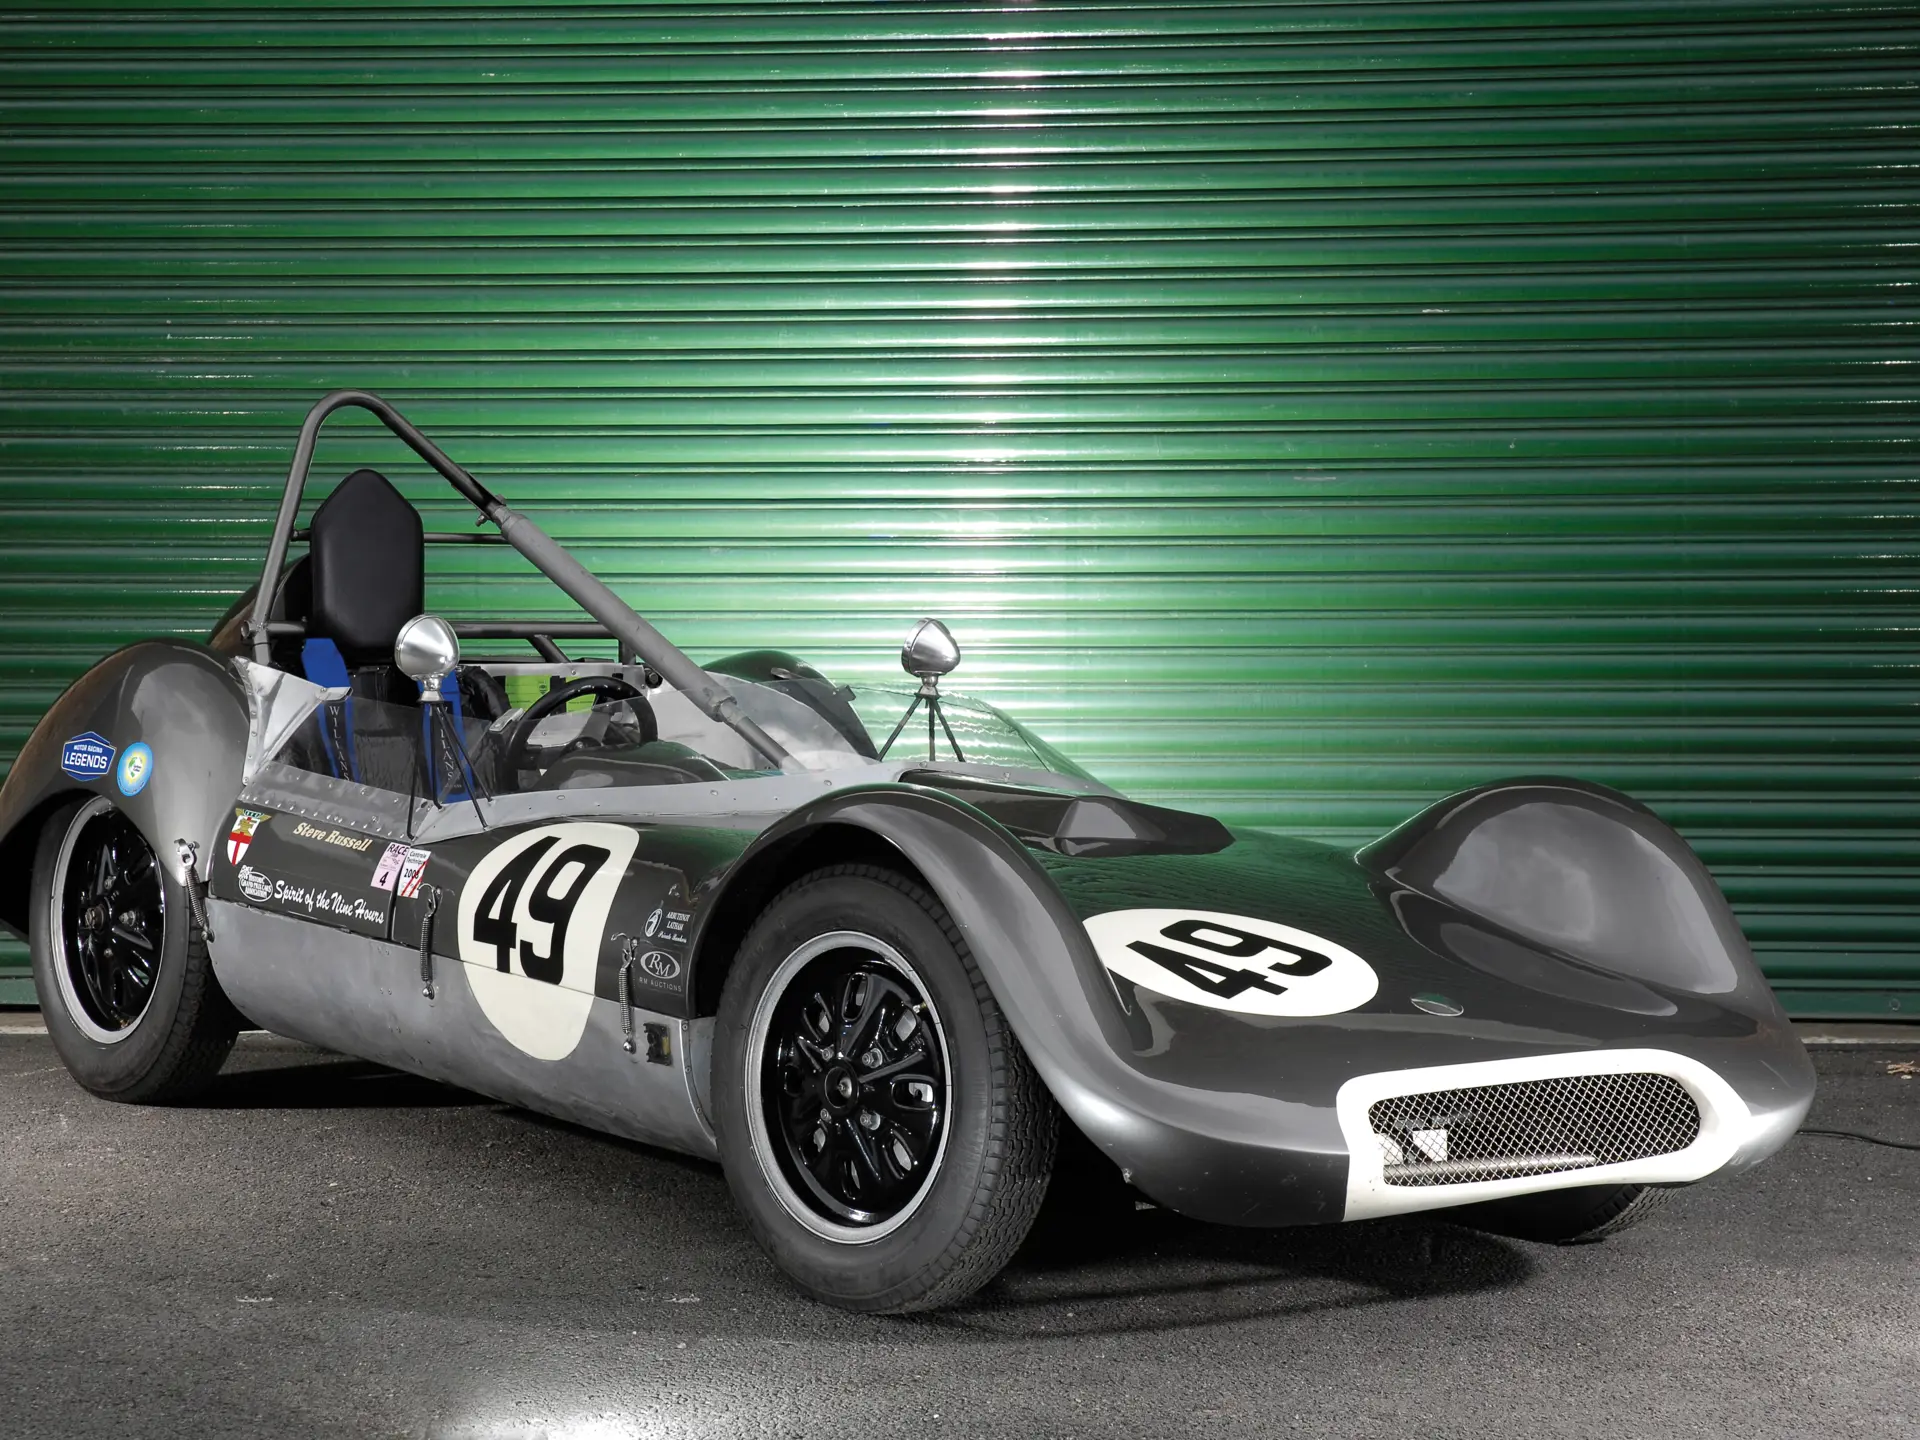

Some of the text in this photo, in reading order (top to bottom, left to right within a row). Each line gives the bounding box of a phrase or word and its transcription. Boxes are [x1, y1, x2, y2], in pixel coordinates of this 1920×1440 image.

[64, 752, 108, 769] LEGENDS
[293, 822, 373, 852] Steve Russell
[387, 844, 409, 856] RACE
[379, 871, 389, 886] 4
[274, 880, 385, 924] Spirit of the Nine Hours
[473, 836, 611, 986] 49
[648, 953, 671, 977] RM
[1126, 919, 1334, 1000] 49
[639, 976, 682, 992] RM AUCTIONS
